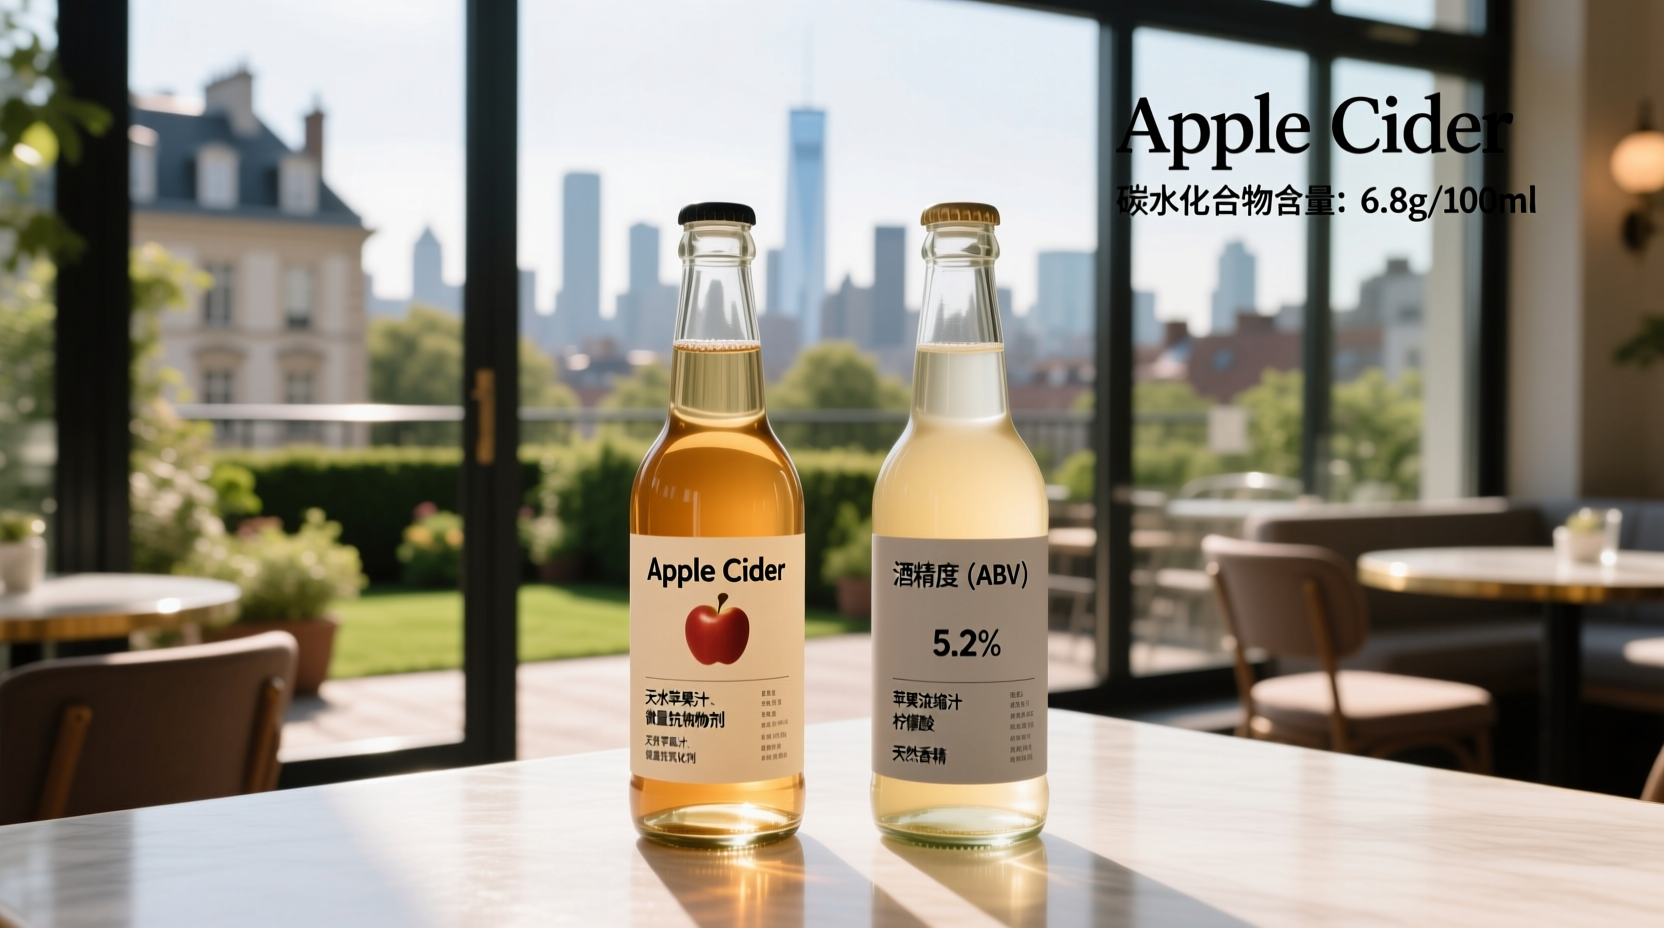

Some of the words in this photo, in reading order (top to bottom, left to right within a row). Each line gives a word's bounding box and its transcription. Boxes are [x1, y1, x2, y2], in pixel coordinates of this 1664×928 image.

[647, 556, 715, 588] Apple
[723, 556, 785, 582] Cider
[893, 560, 959, 588] 酒精度
[968, 561, 1027, 590] (ABV)
[933, 628, 1001, 657] 5.2%
